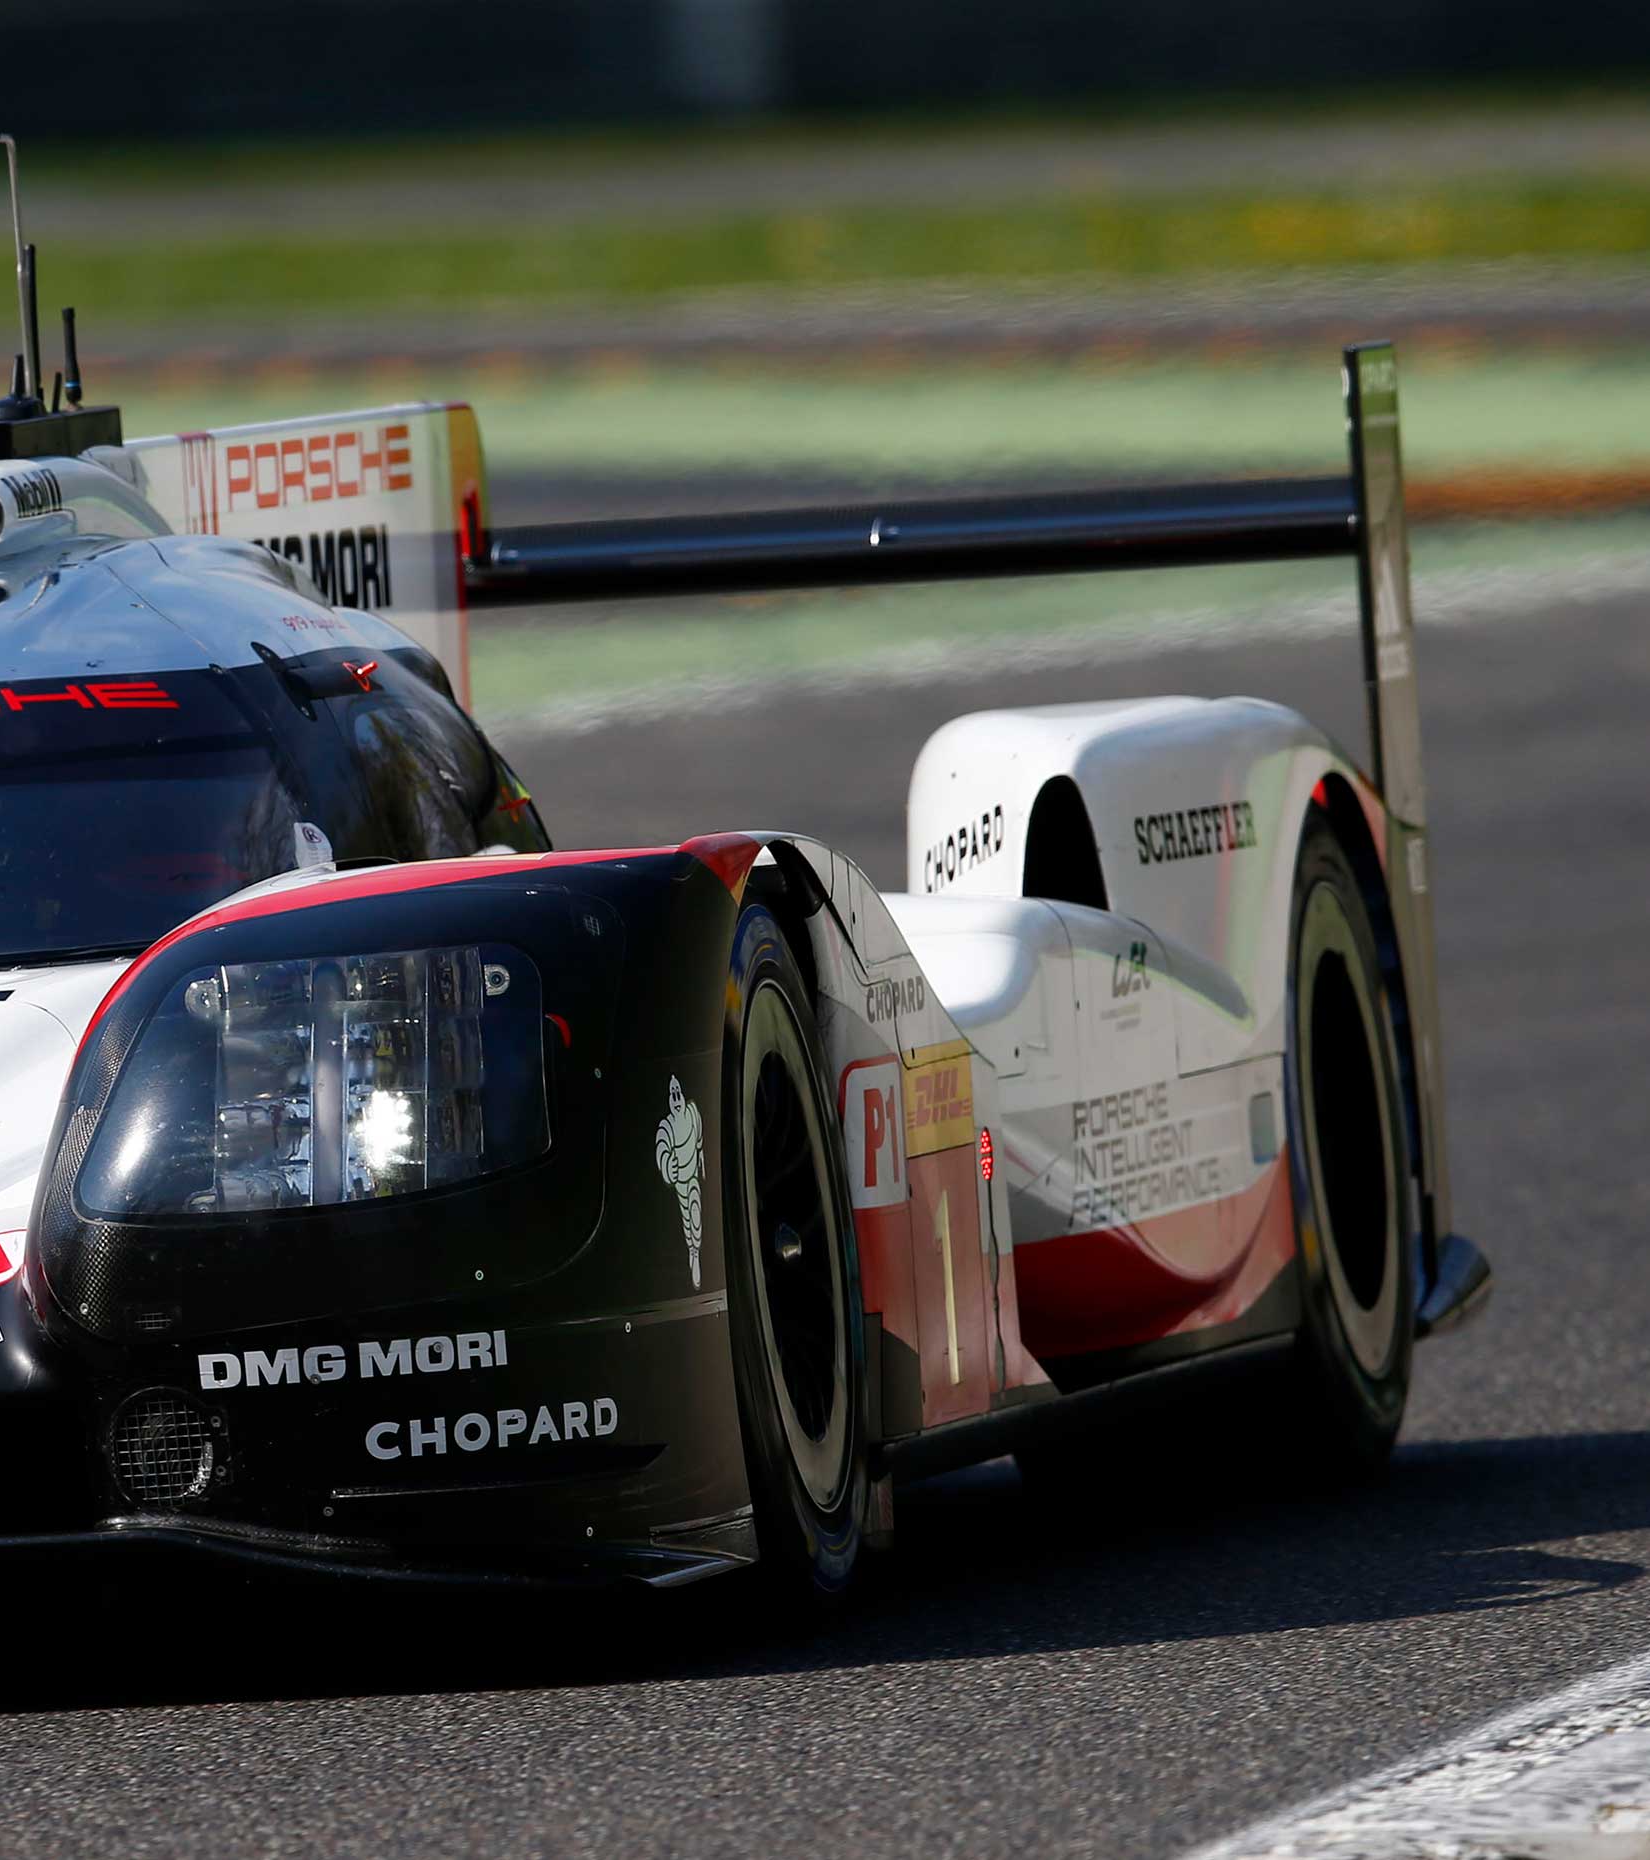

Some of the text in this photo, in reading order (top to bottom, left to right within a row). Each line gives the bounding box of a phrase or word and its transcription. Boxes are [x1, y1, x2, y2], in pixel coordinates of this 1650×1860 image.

[227, 424, 413, 512] PORSCHE
[310, 524, 392, 609] MORI
[924, 805, 1005, 894] CHOPARD
[1134, 801, 1257, 865] SCHAEFFLER
[866, 976, 924, 1023] CHOPARD
[864, 1086, 900, 1188] P1
[1073, 1082, 1168, 1142] PORSCHE
[933, 1190, 961, 1385] 1
[198, 1330, 507, 1390] DMG MORI
[365, 1398, 618, 1460] CHOPARD
